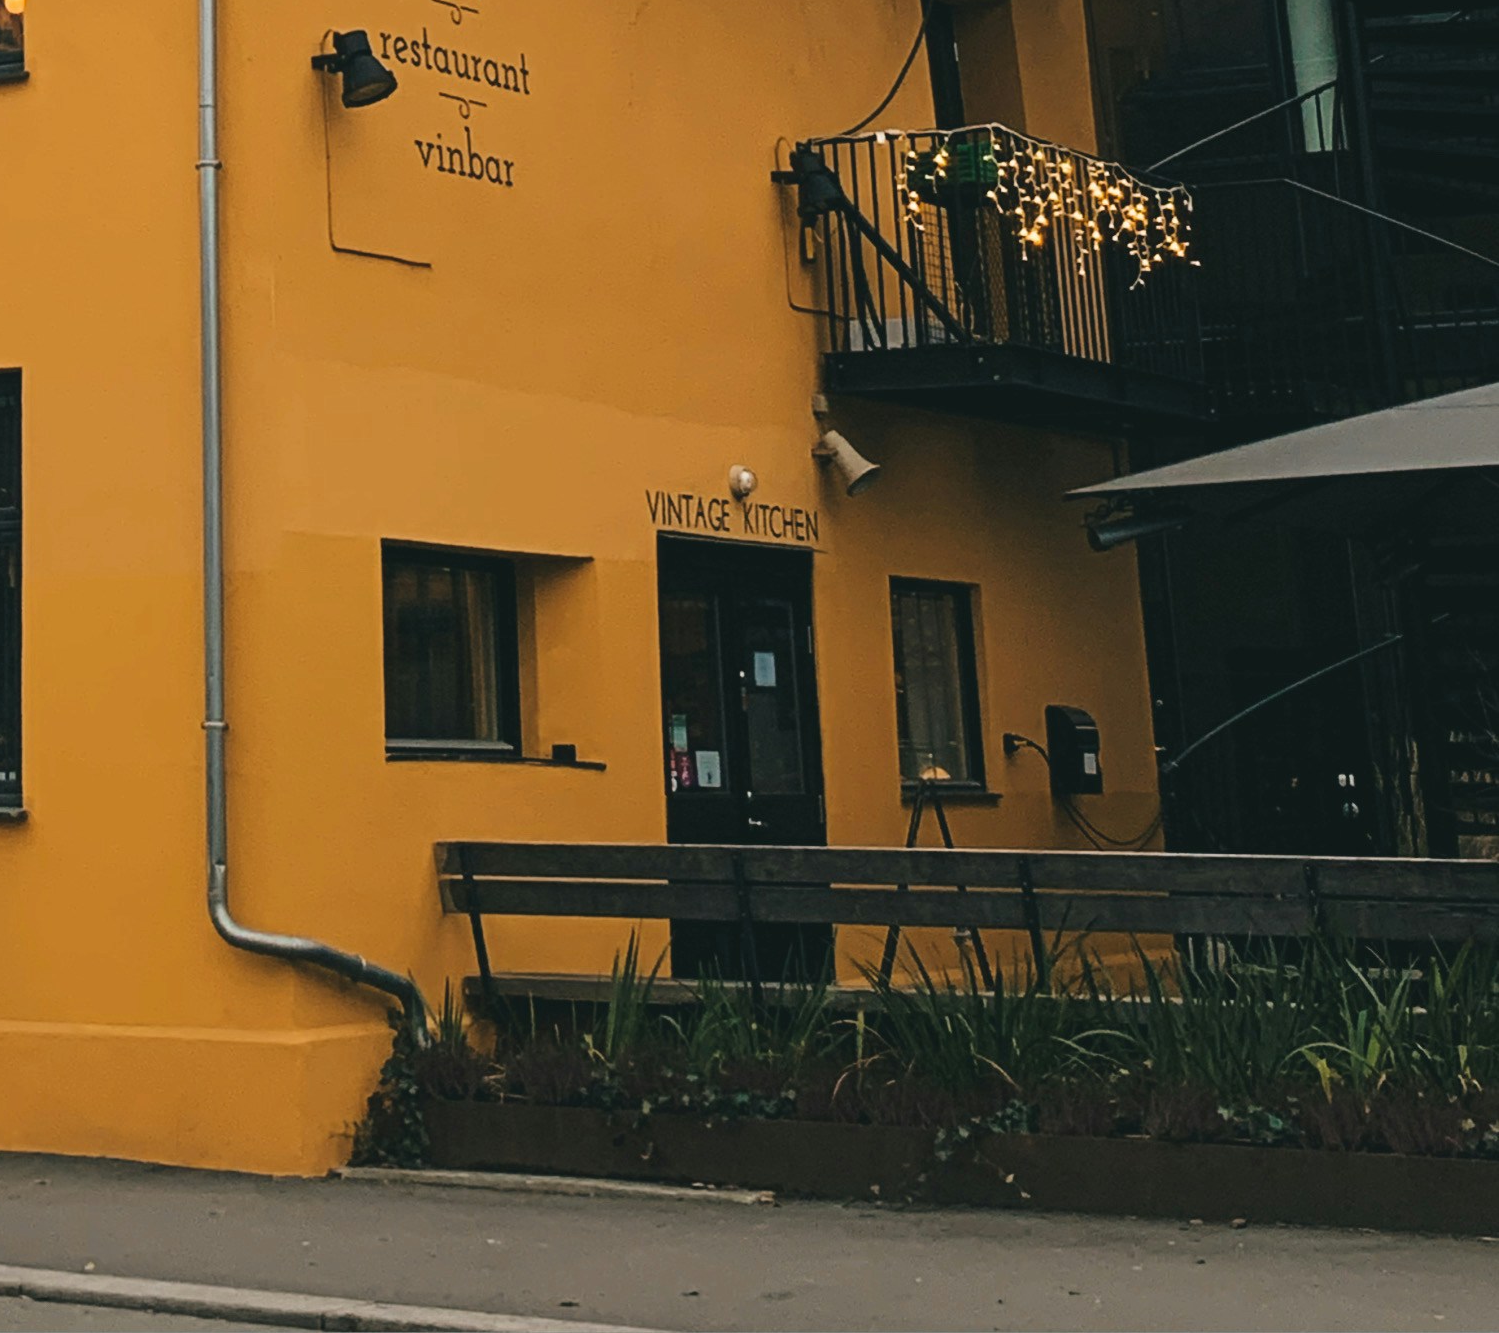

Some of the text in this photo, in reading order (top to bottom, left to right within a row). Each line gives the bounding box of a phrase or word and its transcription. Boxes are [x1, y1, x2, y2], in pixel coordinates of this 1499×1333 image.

[379, 26, 531, 95] restaurant
[414, 125, 514, 187] vinbar
[645, 489, 820, 542] VINTAGE KITCHEN
